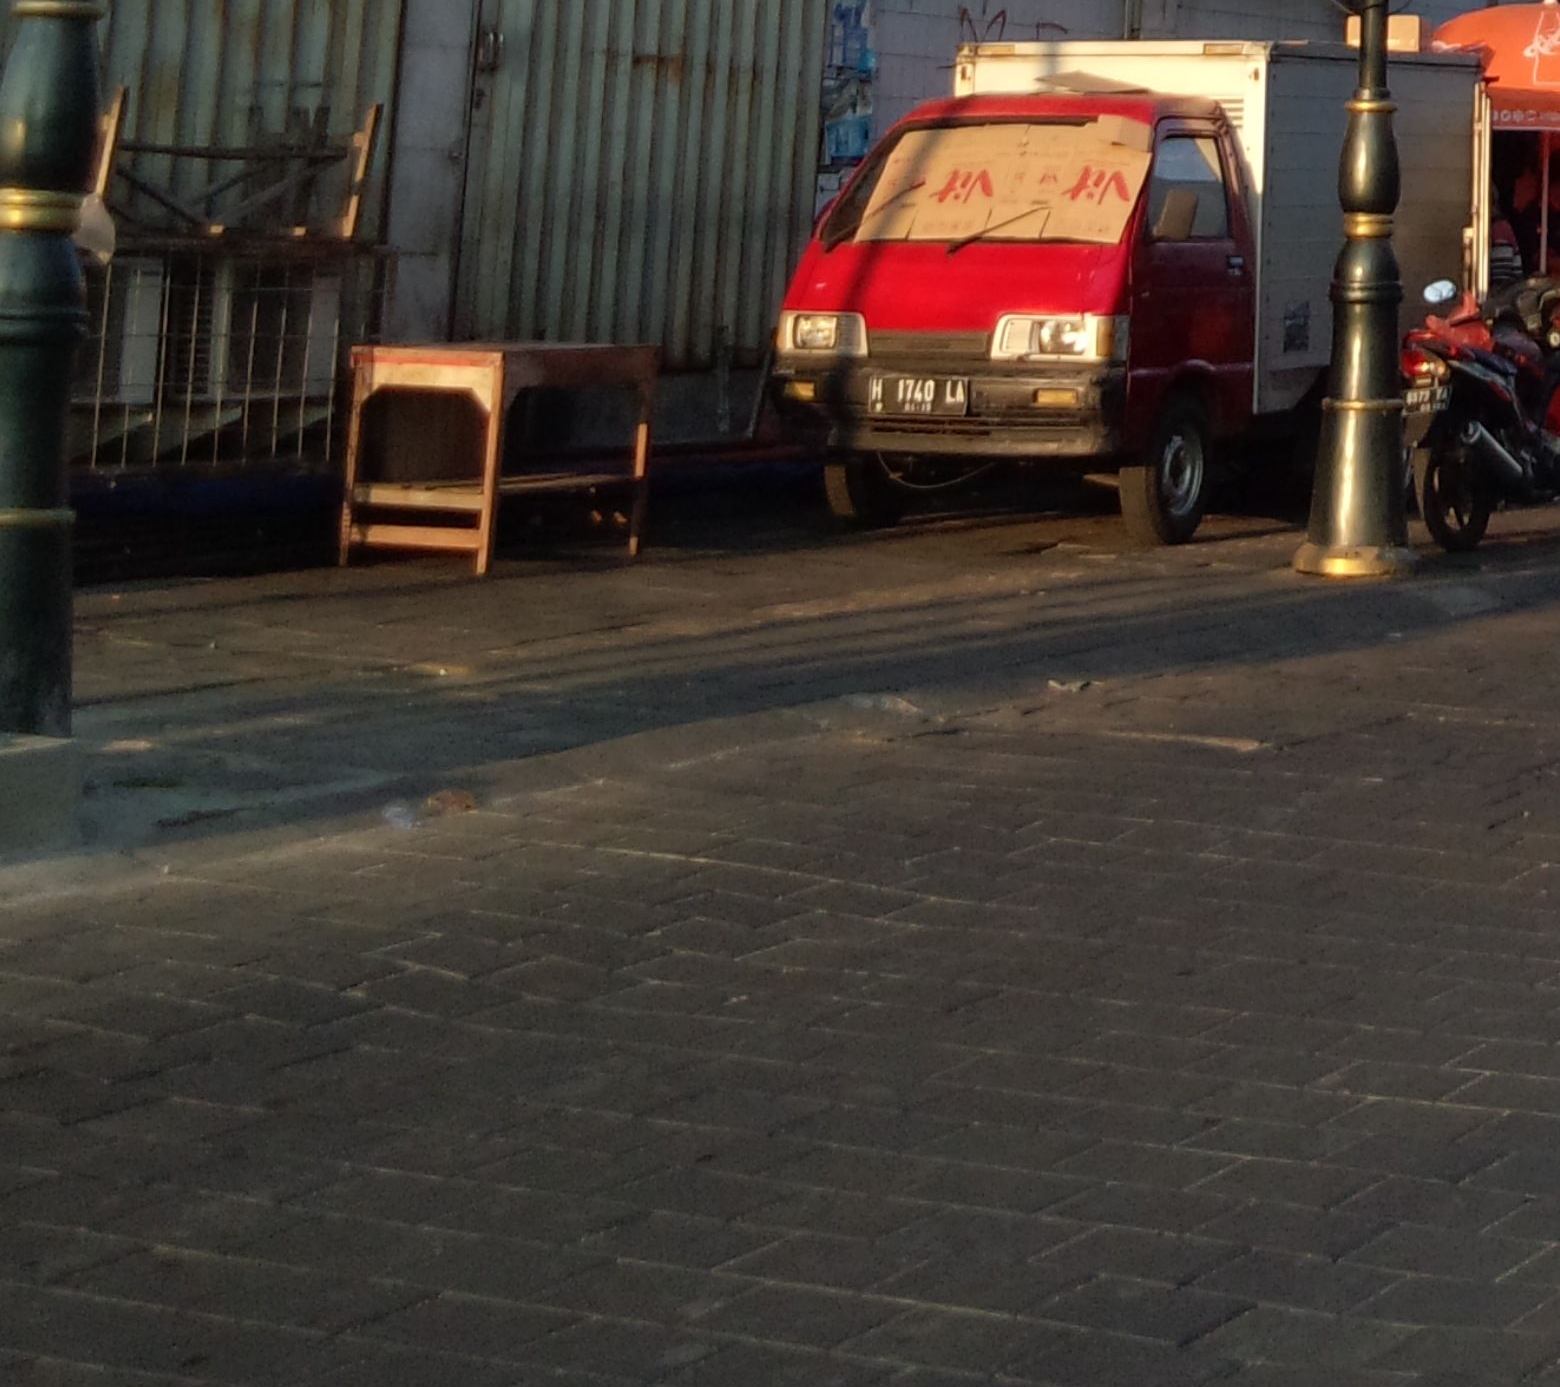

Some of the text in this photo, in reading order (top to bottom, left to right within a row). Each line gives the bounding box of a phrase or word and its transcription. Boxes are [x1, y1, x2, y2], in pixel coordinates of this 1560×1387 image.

[871, 378, 965, 403] H 1740 LA
